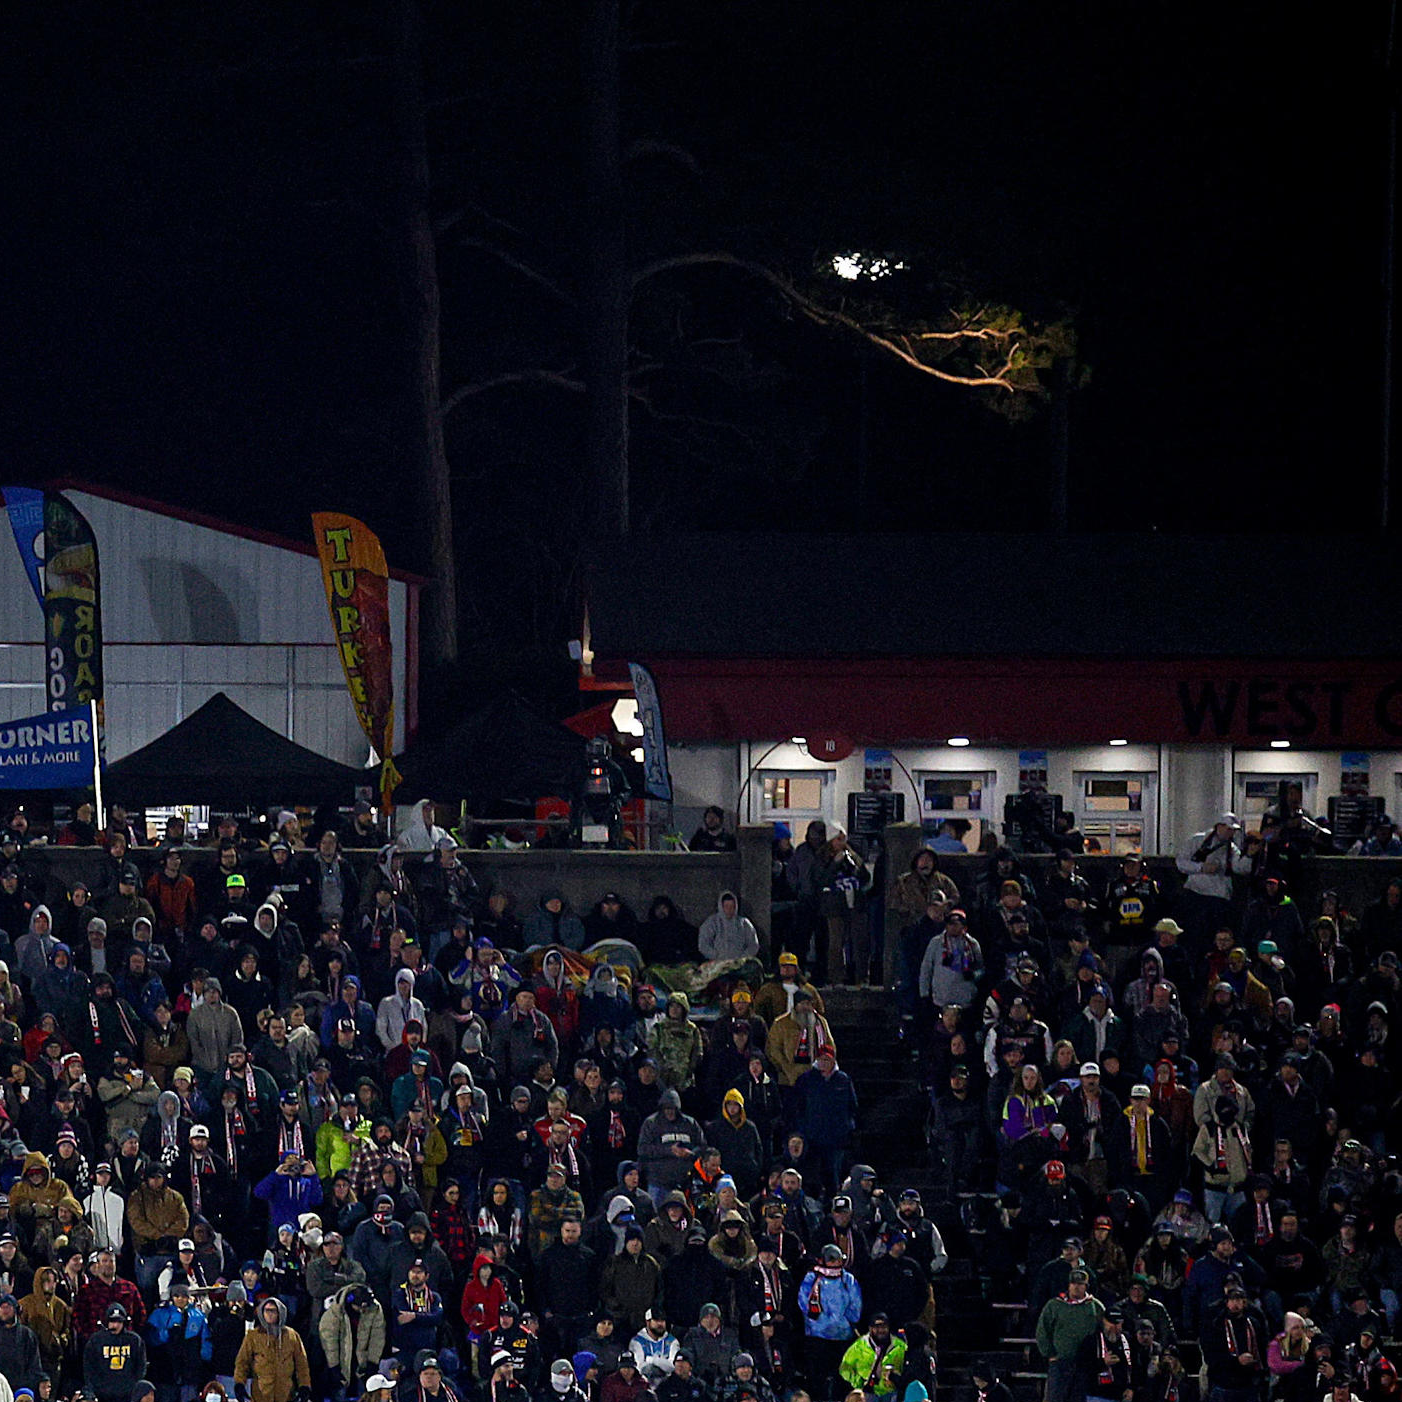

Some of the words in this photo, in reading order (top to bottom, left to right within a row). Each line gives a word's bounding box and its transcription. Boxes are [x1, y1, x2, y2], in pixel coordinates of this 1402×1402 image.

[1178, 680, 1352, 736] WEST
[31, 752, 40, 765] &
[43, 752, 81, 764] MORE
